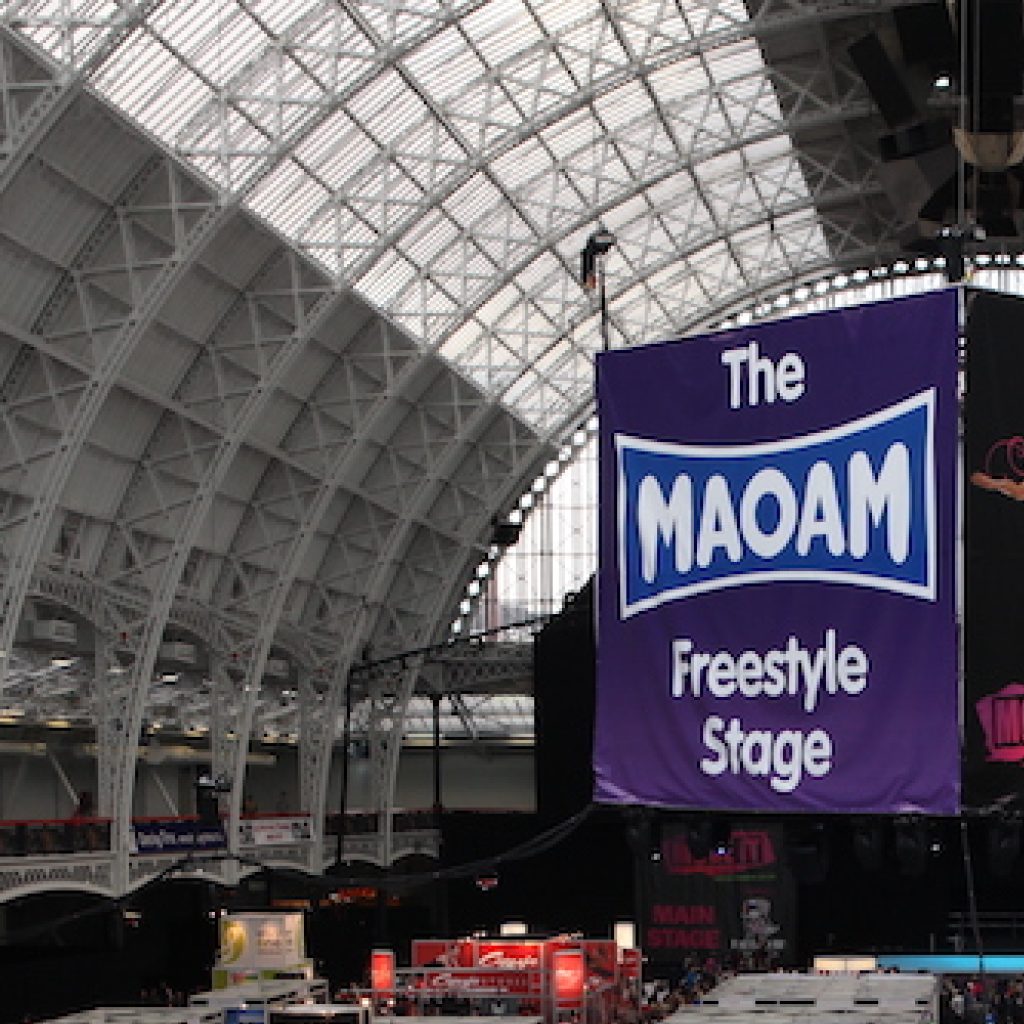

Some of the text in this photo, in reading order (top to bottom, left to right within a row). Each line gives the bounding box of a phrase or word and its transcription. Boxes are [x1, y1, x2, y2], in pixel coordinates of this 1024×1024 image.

[721, 341, 806, 409] The
[637, 441, 911, 584] MAOAM
[671, 628, 868, 713] Freestyle
[700, 714, 834, 793] Stage
[648, 929, 721, 949] STAGE
[653, 904, 715, 924] MAIN
